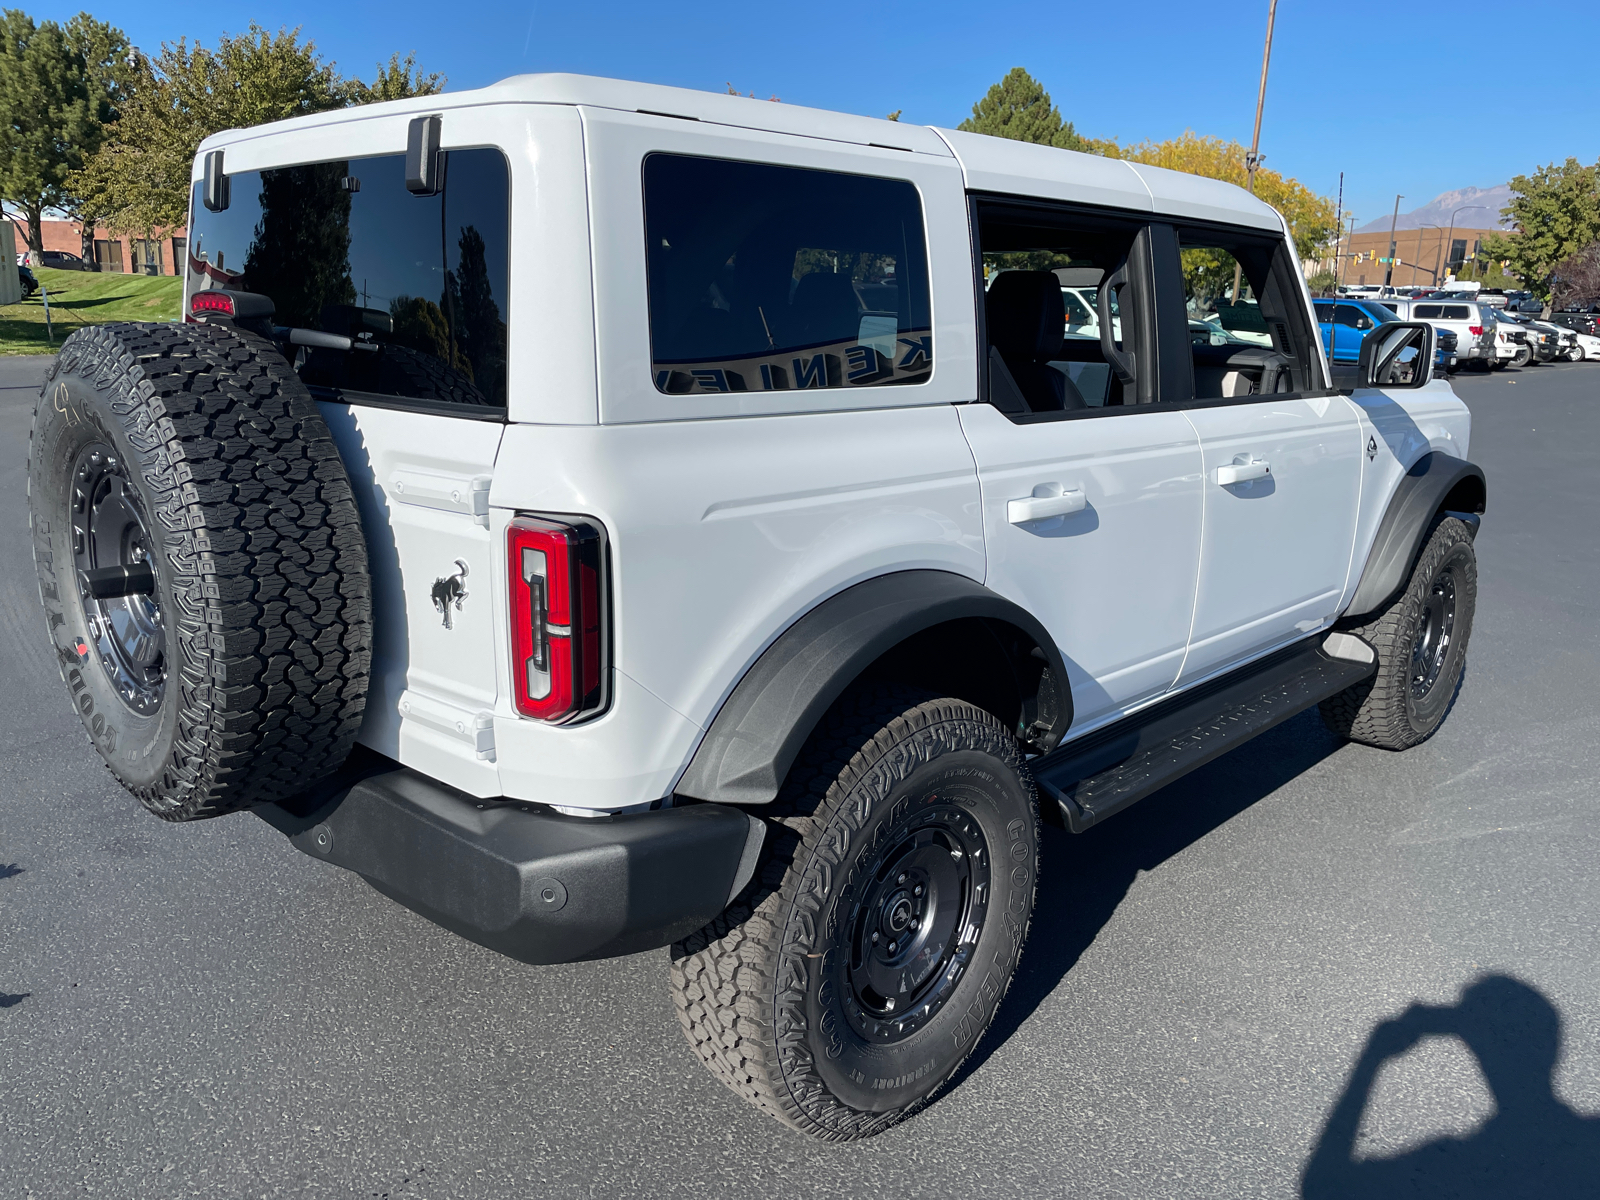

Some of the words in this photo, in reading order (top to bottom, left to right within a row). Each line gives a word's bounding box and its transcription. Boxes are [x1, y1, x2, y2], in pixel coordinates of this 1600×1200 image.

[951, 817, 1029, 1049] GOODYEAR
[848, 1068, 866, 1085] RT
[871, 1058, 938, 1090] TERRITORY
